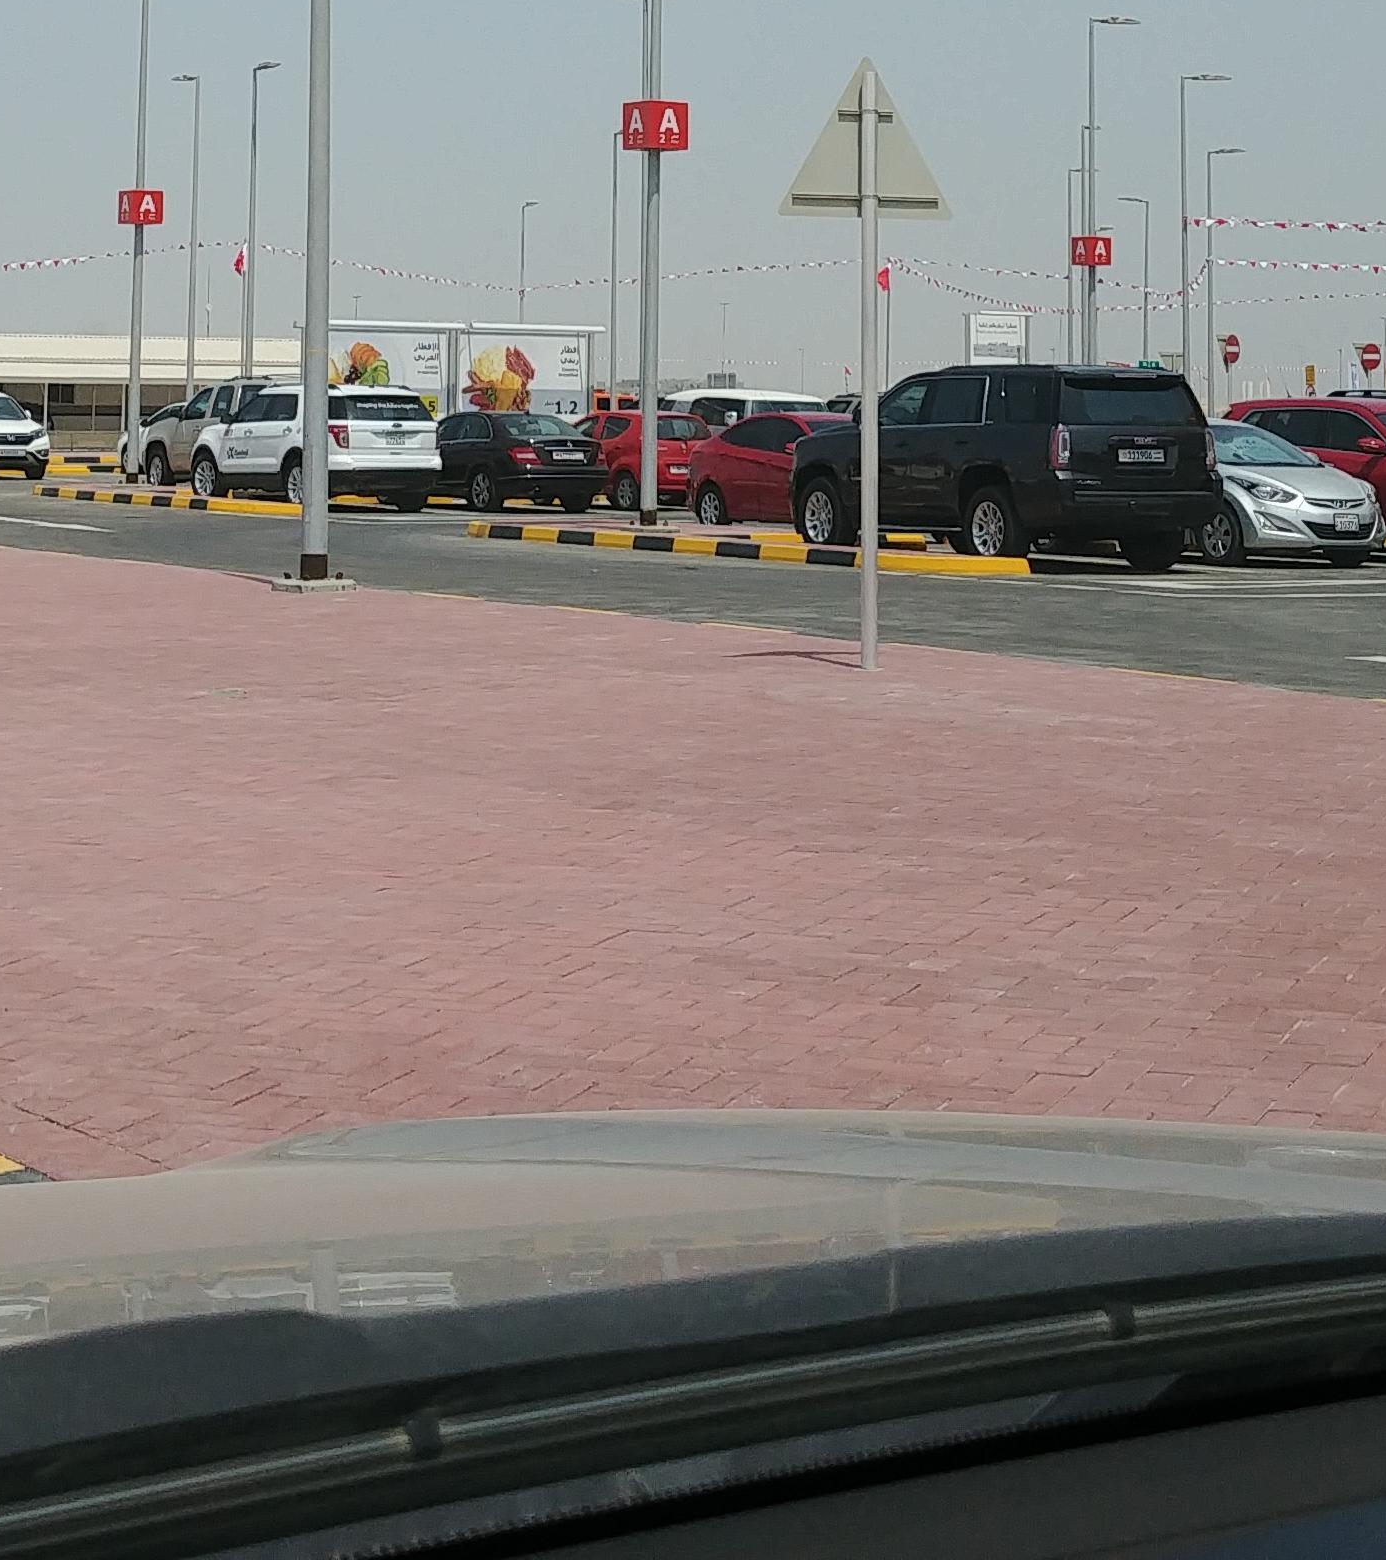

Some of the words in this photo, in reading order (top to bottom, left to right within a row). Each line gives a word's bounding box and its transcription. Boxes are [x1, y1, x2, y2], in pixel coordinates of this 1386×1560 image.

[628, 108, 644, 134] A
[659, 108, 680, 134] A
[659, 134, 666, 144] 2
[120, 194, 130, 213] A
[139, 194, 156, 213] A
[1075, 240, 1086, 256] A
[1094, 240, 1107, 257] A
[428, 400, 436, 413] 5
[555, 400, 579, 415] 1.2
